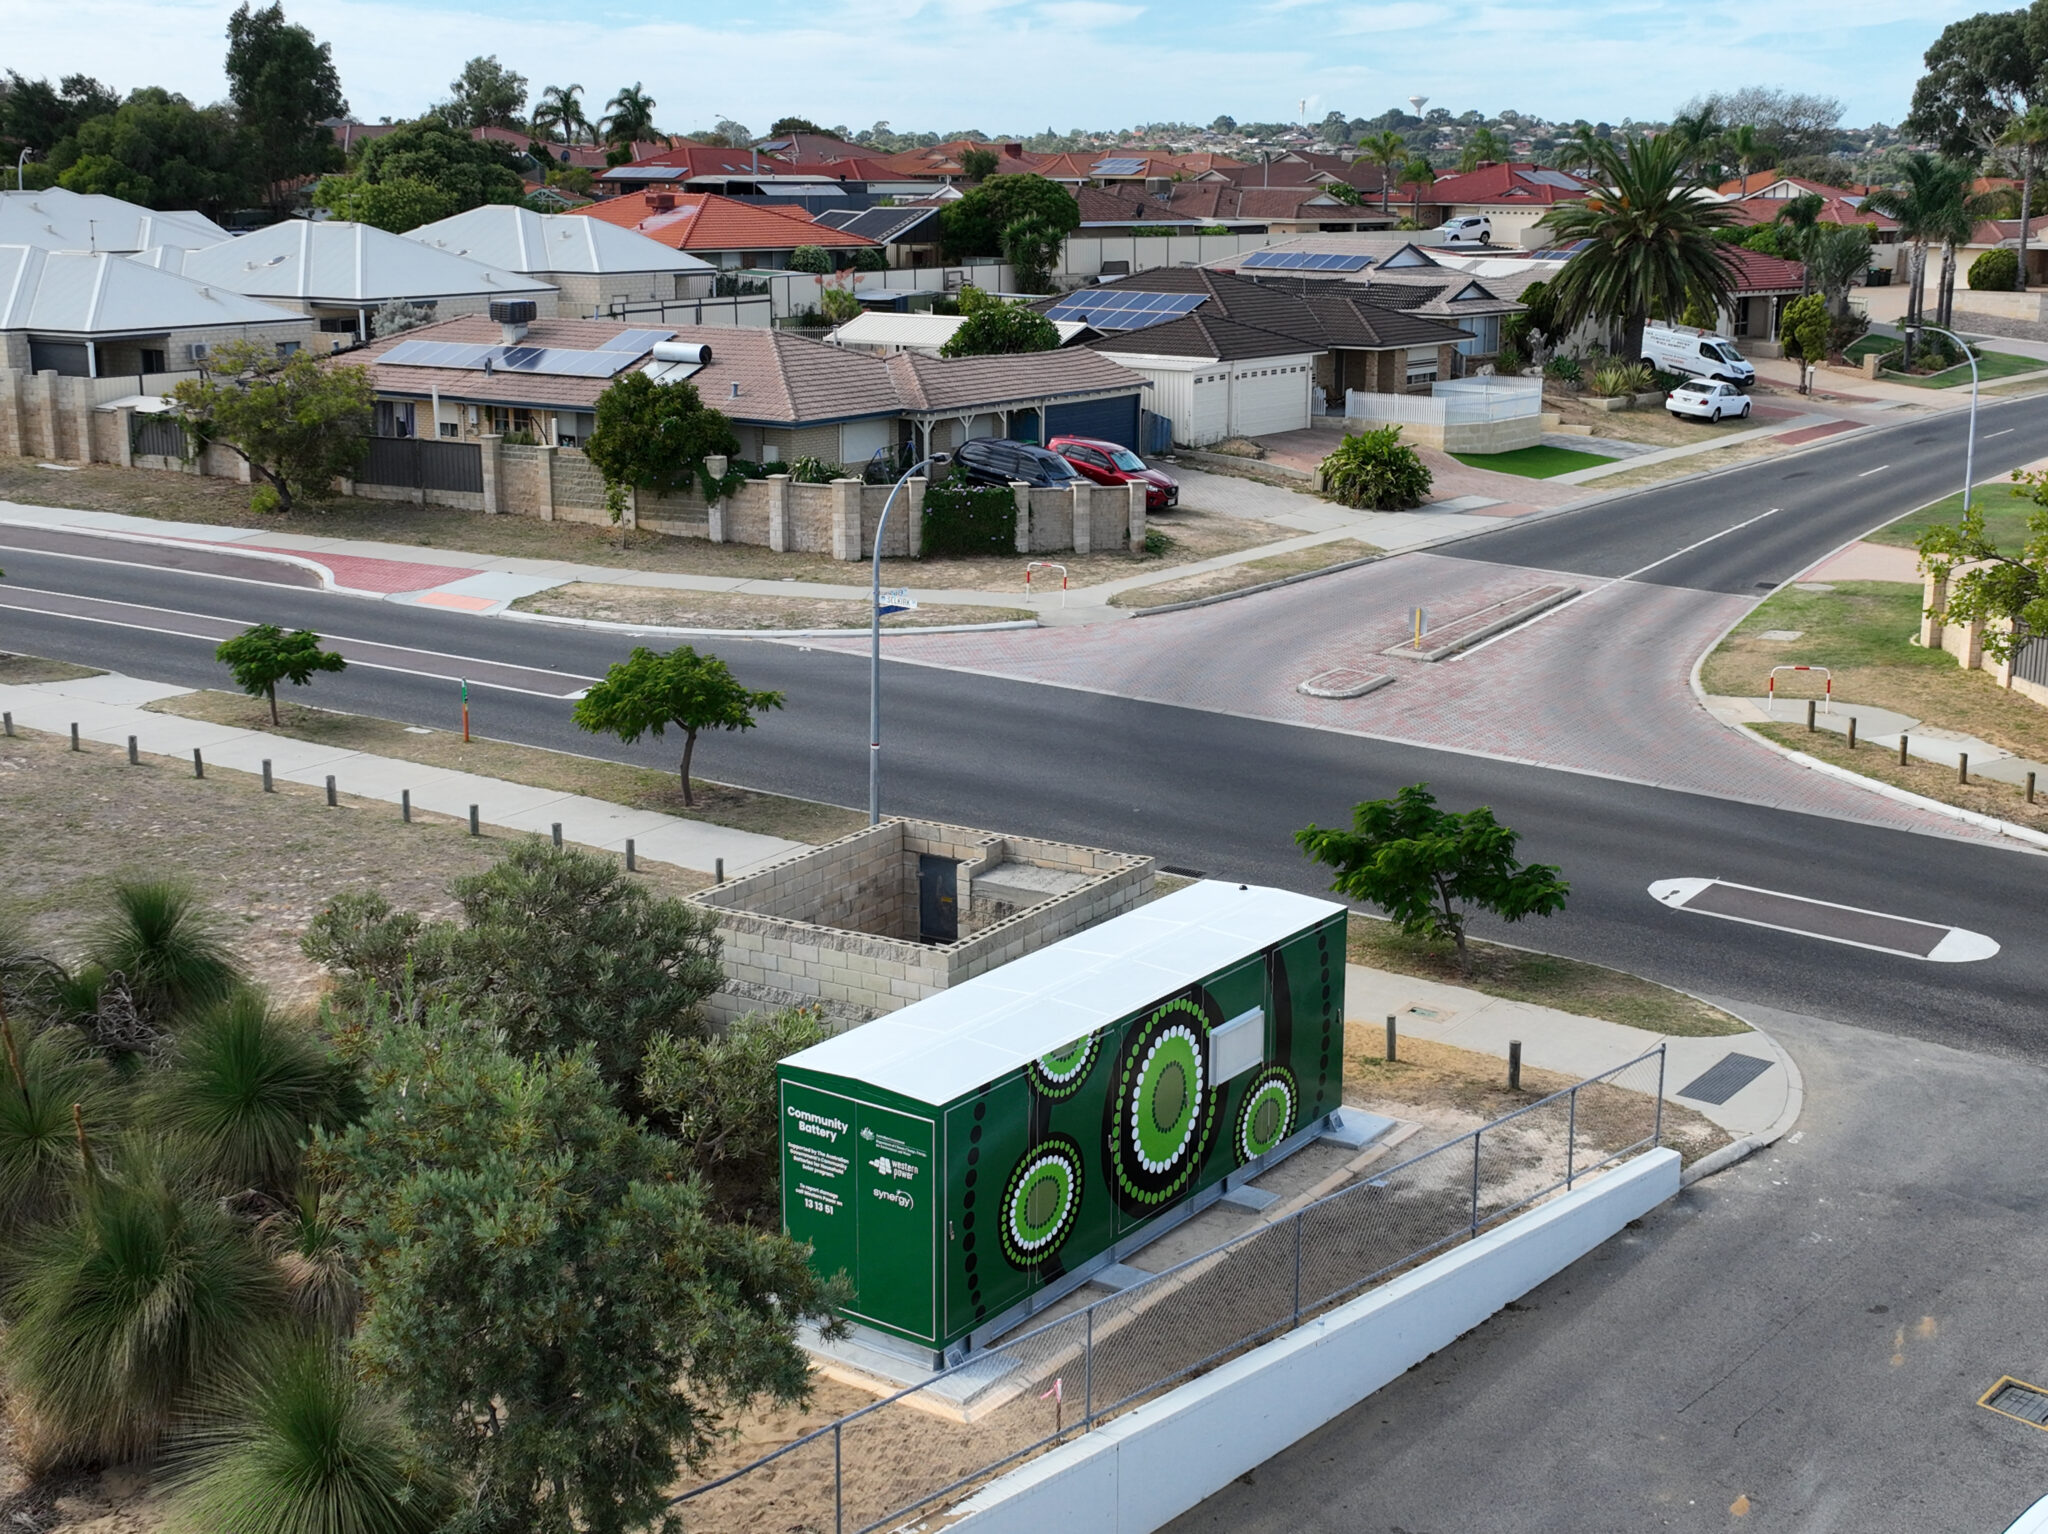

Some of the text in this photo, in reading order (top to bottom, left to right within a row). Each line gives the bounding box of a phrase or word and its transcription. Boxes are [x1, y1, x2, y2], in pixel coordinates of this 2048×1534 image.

[787, 1105, 848, 1135] Community
[798, 1120, 838, 1143] Battery
[892, 1160, 919, 1174] western
[893, 1168, 913, 1180] power
[804, 1198, 834, 1215] 13 13 51
[873, 1188, 910, 1208] synergy
